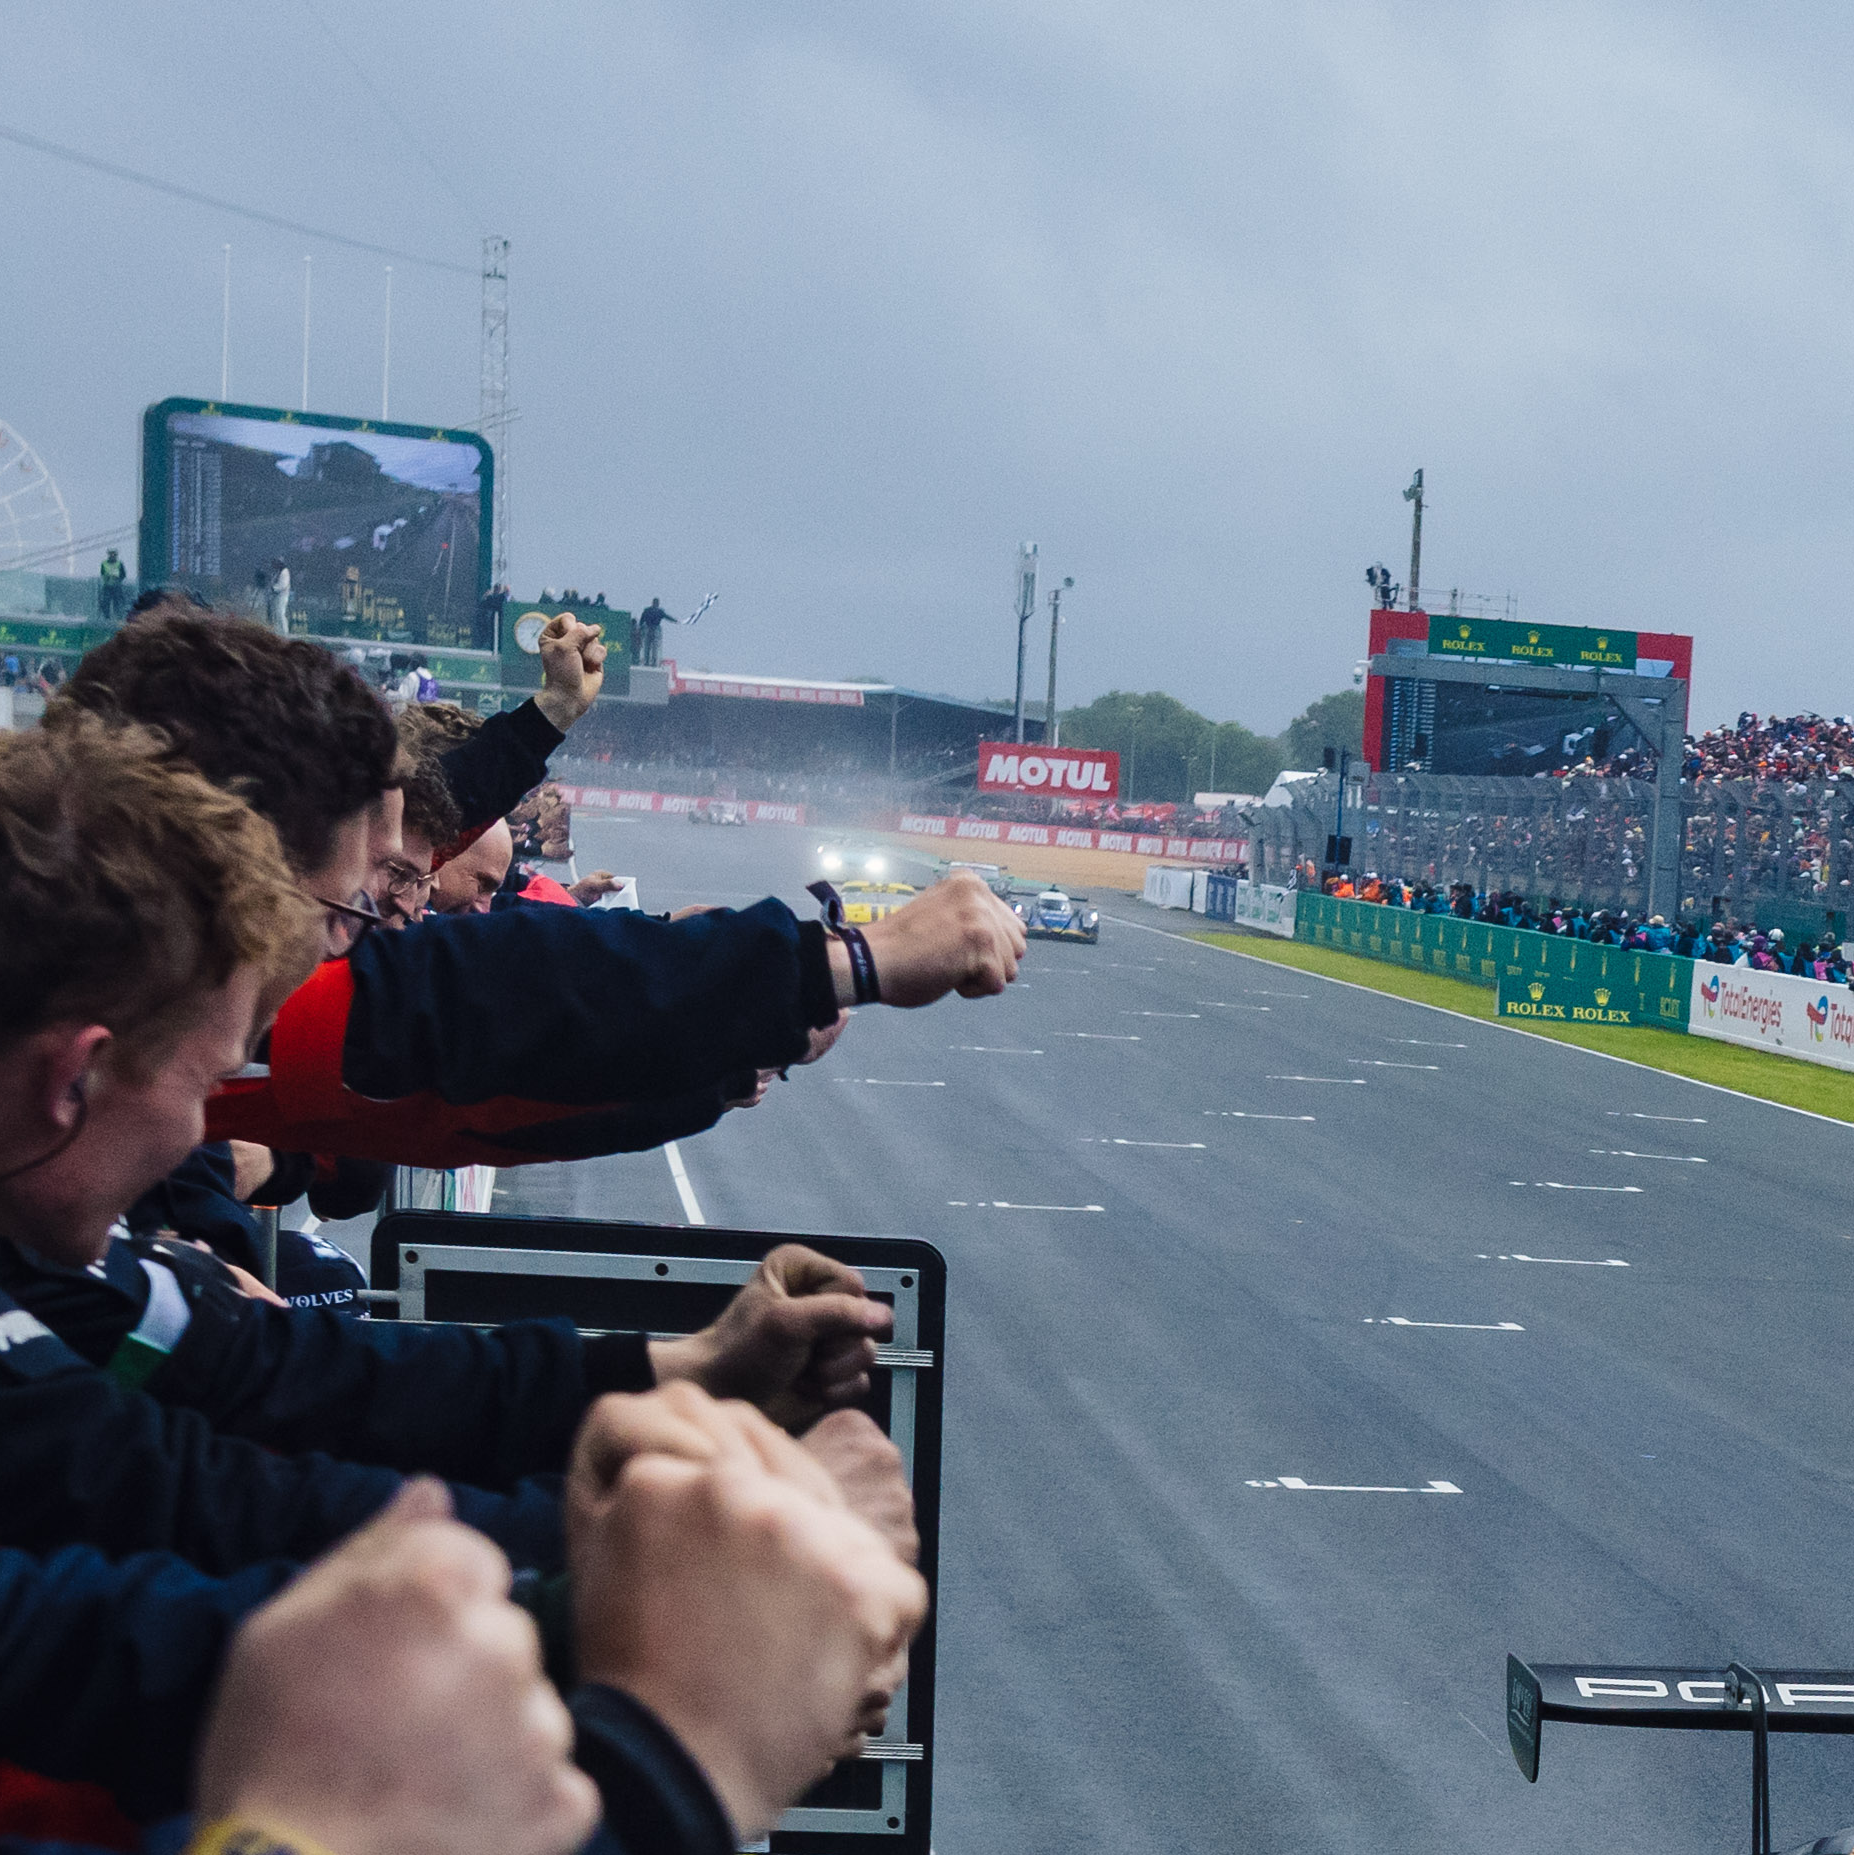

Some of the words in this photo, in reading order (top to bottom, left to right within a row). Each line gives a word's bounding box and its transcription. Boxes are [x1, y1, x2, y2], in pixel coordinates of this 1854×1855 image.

[1442, 640, 1485, 652] ROLEX
[1511, 645, 1554, 658] ROLEX
[1580, 651, 1622, 663] ROLEX
[984, 753, 1112, 792] MOTUL
[756, 804, 798, 825] MOTUL
[901, 815, 947, 836] MOTUL
[956, 821, 1000, 839] MOTUL
[1008, 825, 1049, 844] MOTUL
[1057, 830, 1092, 848] MOTUL
[1099, 834, 1133, 852] MOTUL
[1507, 1002, 1565, 1018] ROLEX
[1572, 1007, 1631, 1023] ROLEX
[1719, 981, 1782, 1034] TotalEnergies
